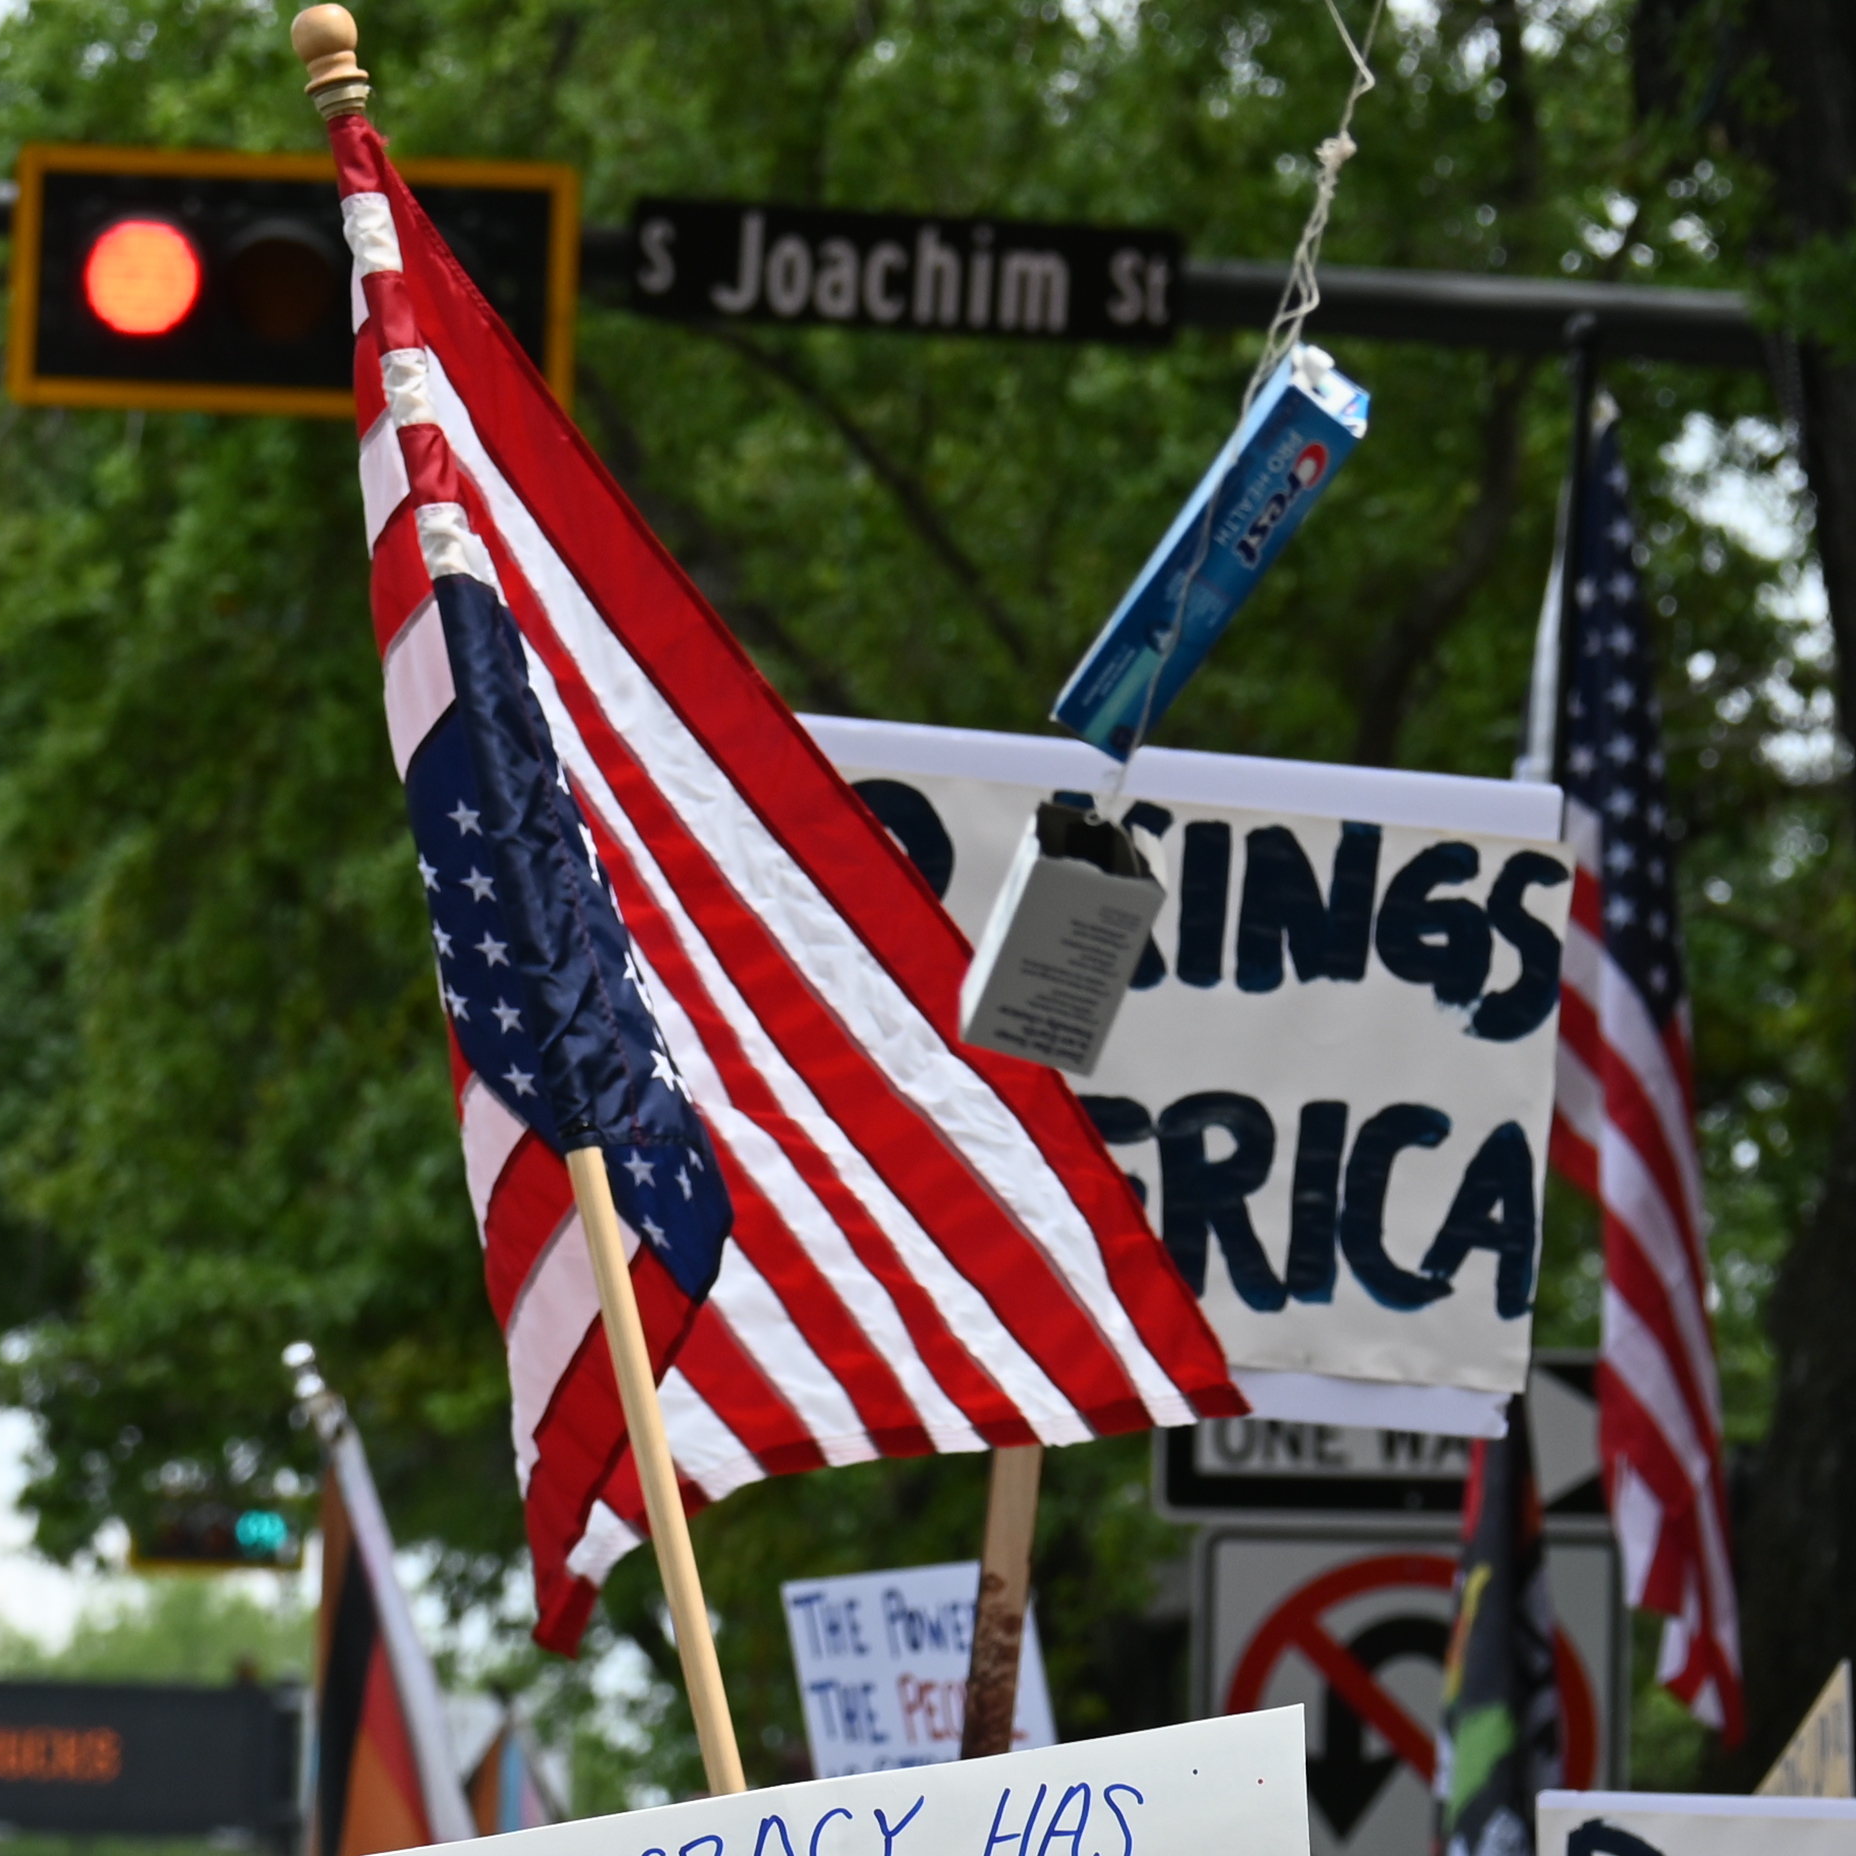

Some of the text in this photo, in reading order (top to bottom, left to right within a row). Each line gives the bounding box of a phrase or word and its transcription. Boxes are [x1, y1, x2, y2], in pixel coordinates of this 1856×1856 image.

[638, 210, 1170, 334] S Joachim St
[1234, 440, 1330, 571] Crest
[1380, 1429, 1474, 1463] WA
[792, 1586, 980, 1661] THE POWE
[809, 1679, 892, 1745] THE
